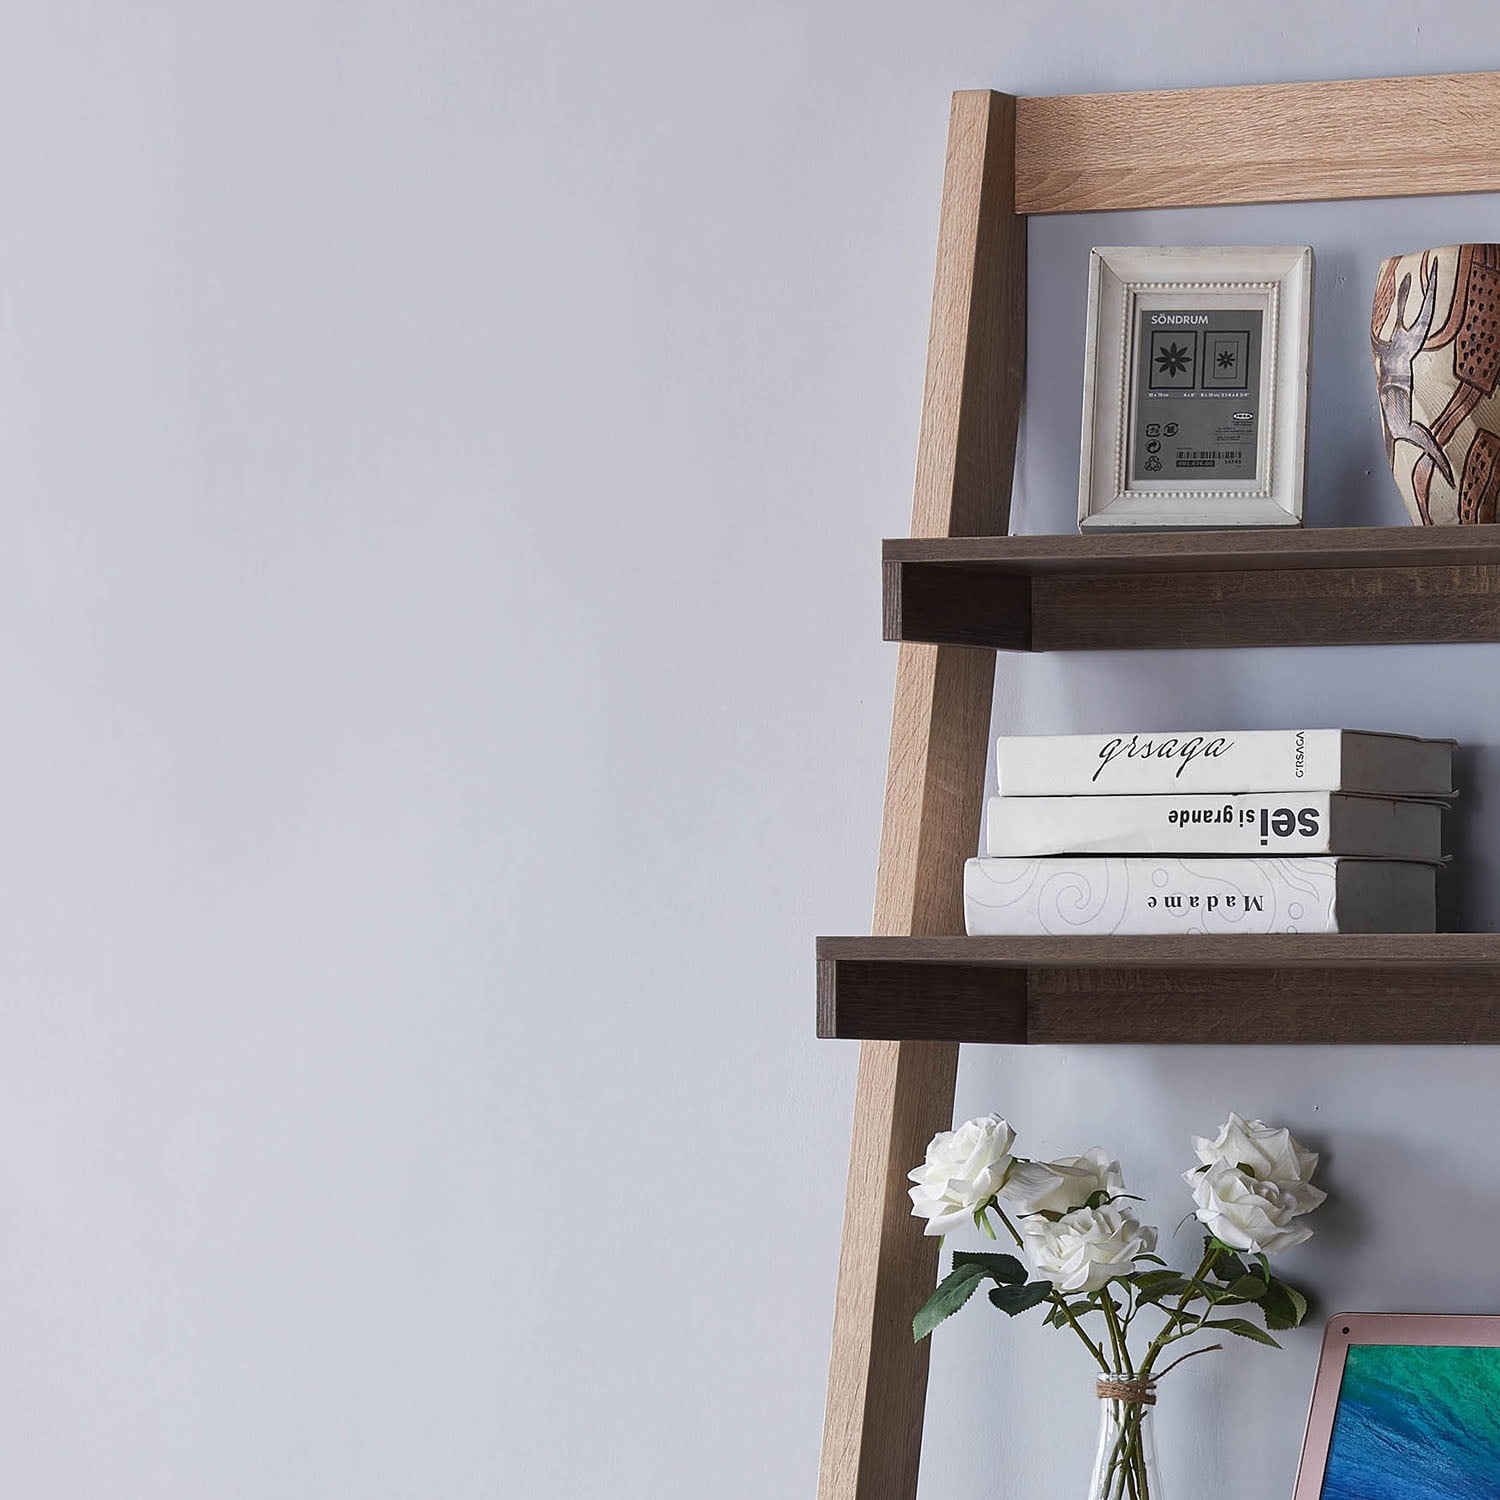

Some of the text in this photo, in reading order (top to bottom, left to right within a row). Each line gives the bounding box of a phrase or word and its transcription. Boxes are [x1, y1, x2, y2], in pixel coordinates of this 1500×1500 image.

[1151, 312, 1209, 325] SÖNDRUM
[1168, 805, 1320, 846] sei si grande
[1147, 895, 1263, 912] Madame
